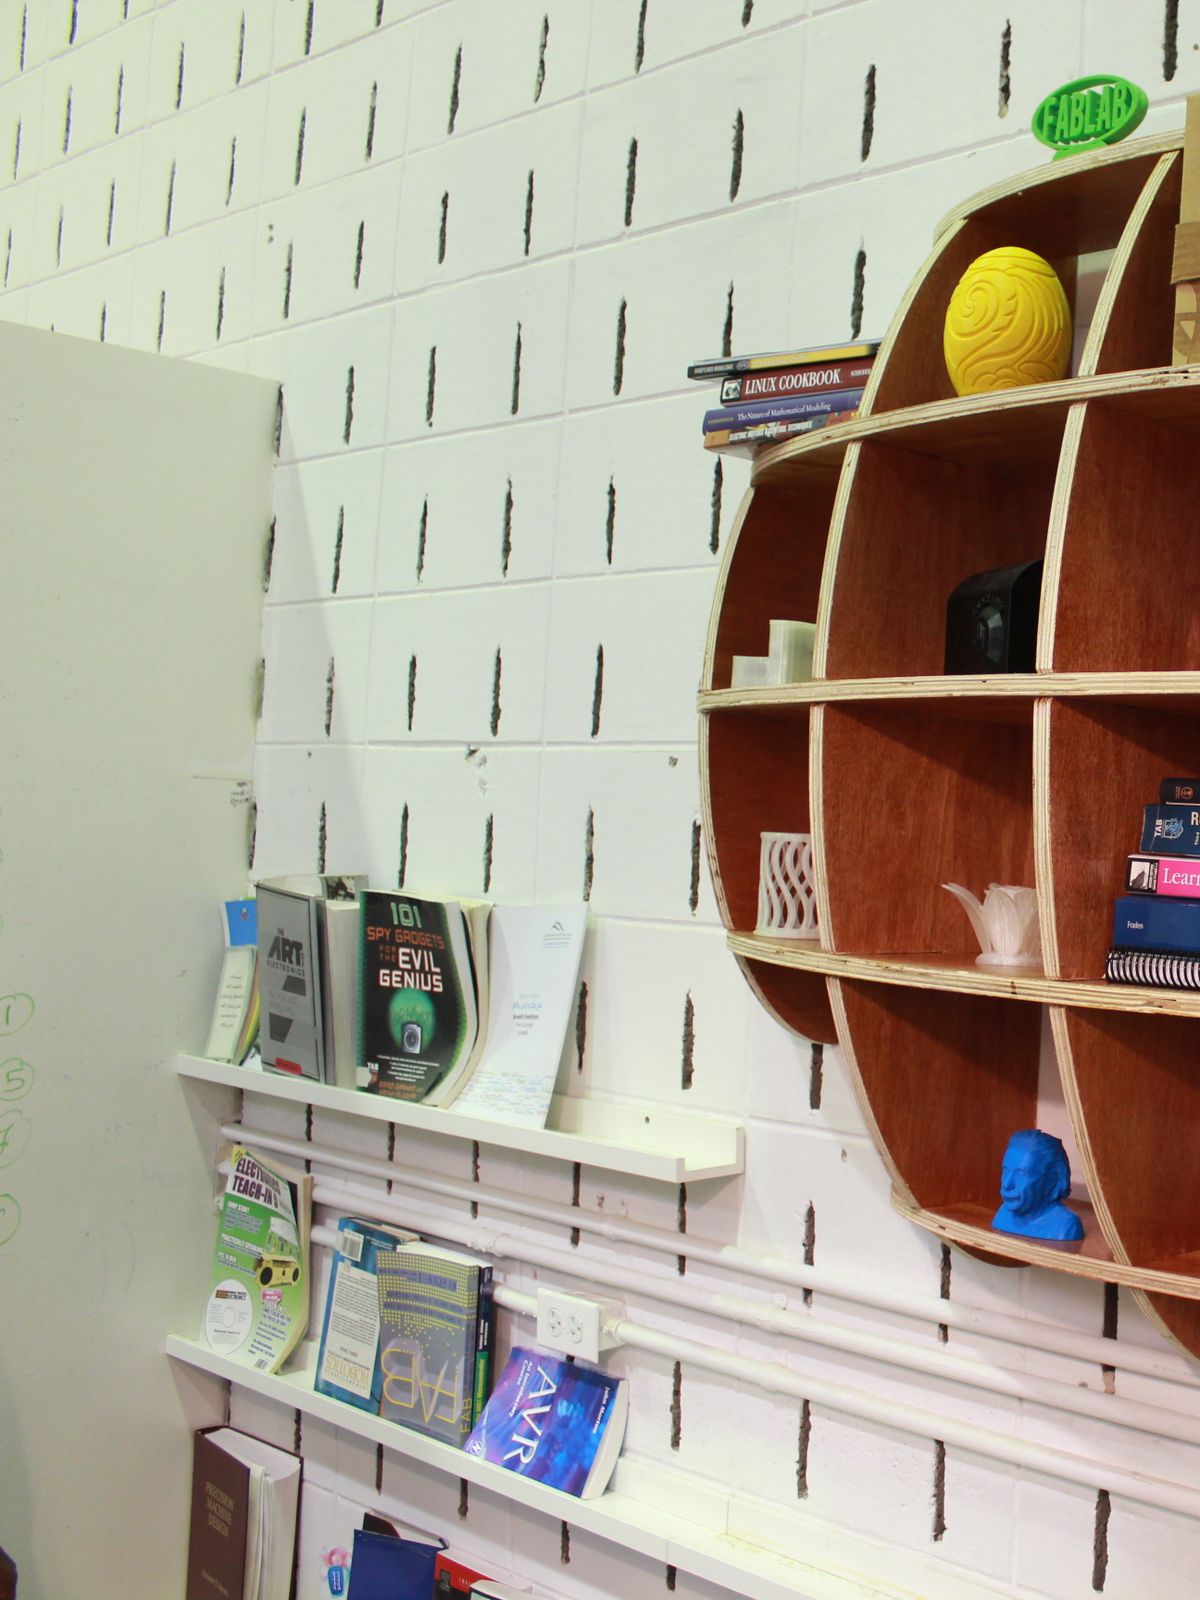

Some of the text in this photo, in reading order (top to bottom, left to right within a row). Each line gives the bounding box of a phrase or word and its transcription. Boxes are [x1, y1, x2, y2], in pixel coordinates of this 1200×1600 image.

[1042, 83, 1128, 144] FABLAB
[744, 368, 841, 395] LINUX COOKBOOK
[737, 413, 748, 421] The
[748, 411, 764, 420] Nature
[771, 405, 806, 417] Mathematical
[806, 402, 831, 414] Modeling
[1153, 819, 1163, 838] TAB
[390, 902, 421, 928] 101
[1127, 920, 1144, 930] Fraden
[267, 935, 304, 967] ART
[367, 926, 445, 950] SPY GADGETS
[266, 960, 306, 977] ELECTRONICS
[398, 947, 441, 973] EVIL
[379, 969, 443, 993] GENIUS
[3, 1068, 25, 1092] 5
[232, 1175, 273, 1206] TEACH-IN
[517, 1360, 528, 1386] Course
[508, 1360, 534, 1418] An Introductory
[460, 1398, 472, 1433] FAB
[503, 1365, 557, 1464] AVR
[592, 1386, 610, 1434] John Morton
[205, 1481, 234, 1511] PRECISION
[206, 1497, 233, 1526] MACHINE
[208, 1512, 229, 1537] DESIGN
